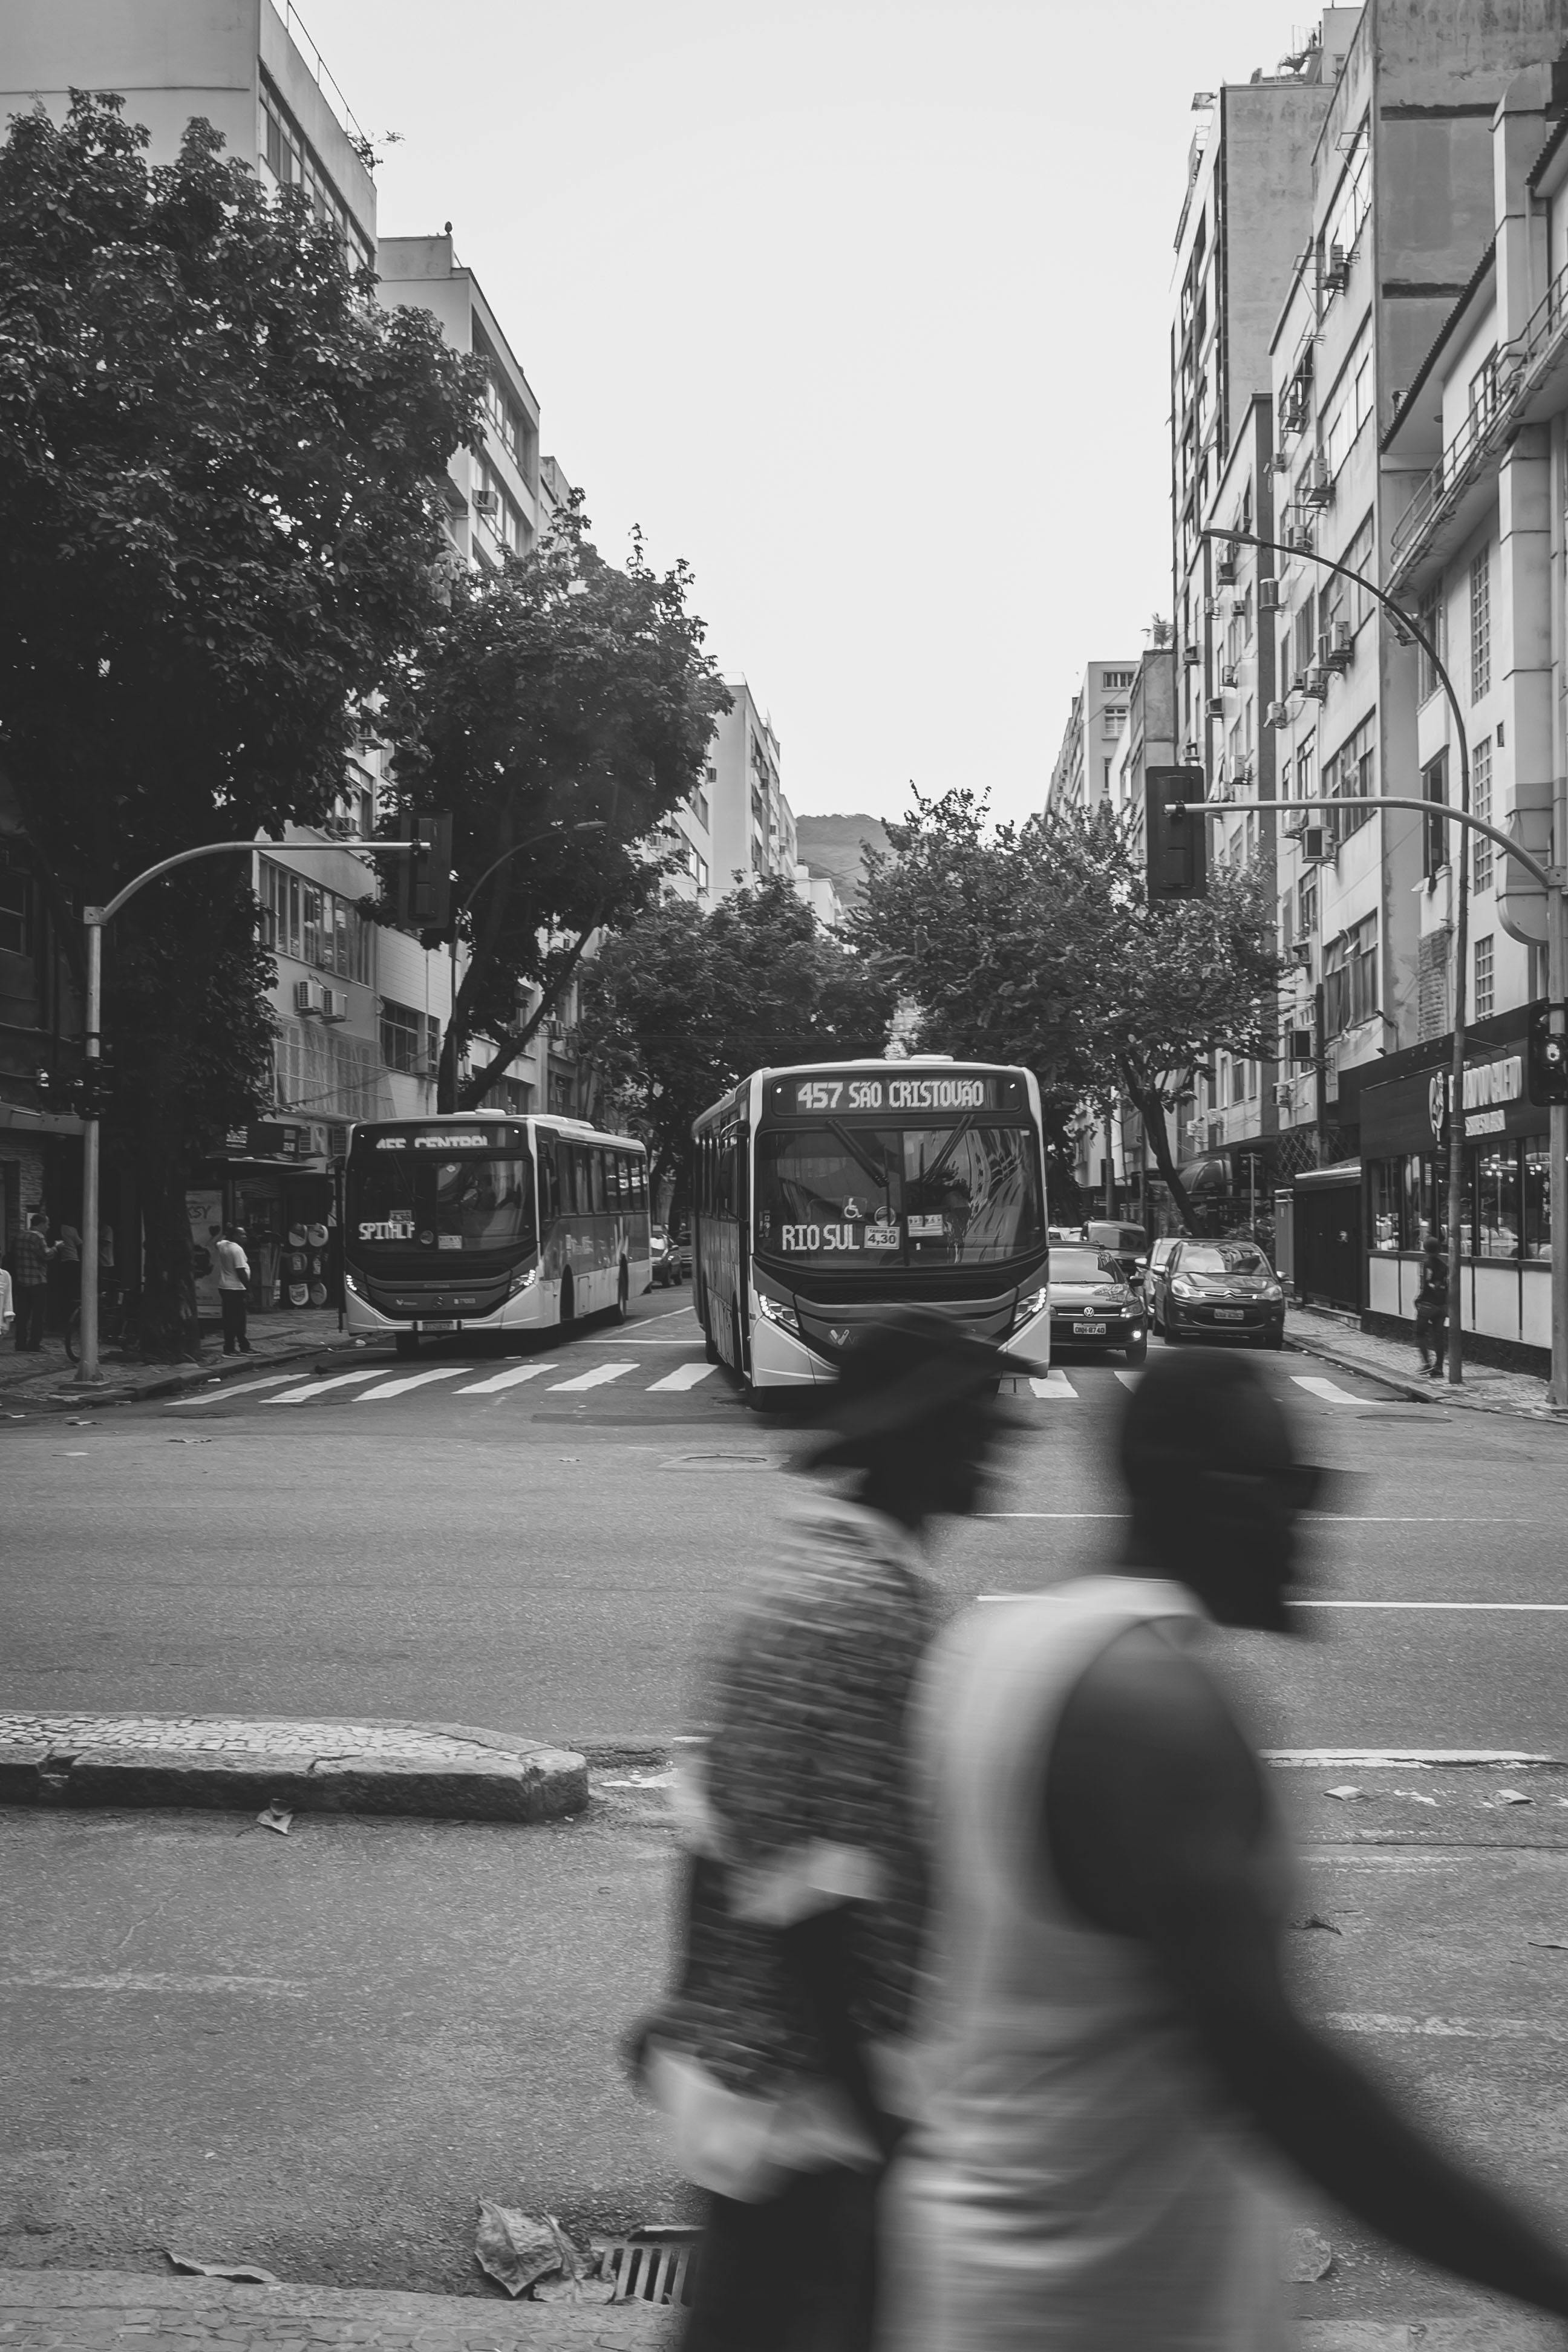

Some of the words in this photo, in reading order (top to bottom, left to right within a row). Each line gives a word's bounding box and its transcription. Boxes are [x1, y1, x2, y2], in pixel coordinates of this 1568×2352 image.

[797, 1082, 844, 1109] 457
[848, 1081, 883, 1108] SÃO
[782, 1224, 820, 1250] RIO
[823, 1224, 860, 1250] SUL
[867, 1233, 897, 1246] 4,30
